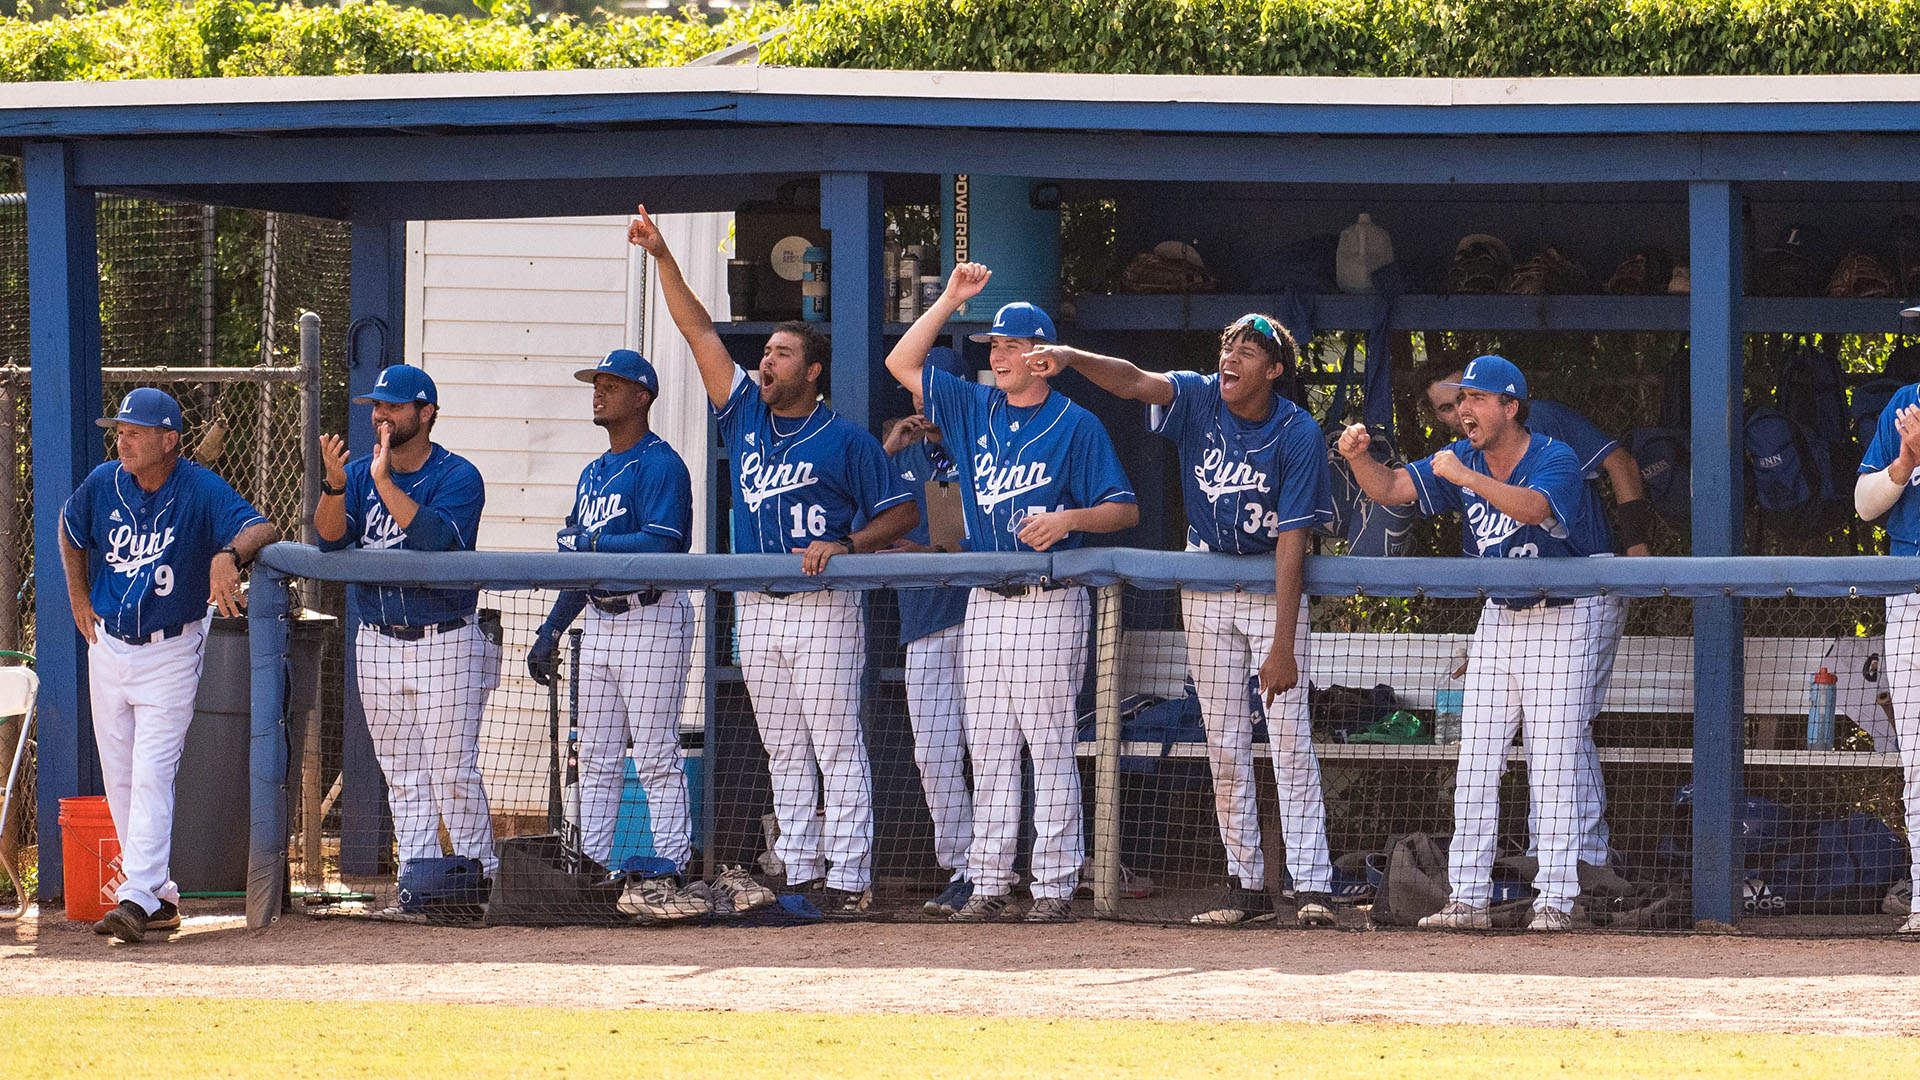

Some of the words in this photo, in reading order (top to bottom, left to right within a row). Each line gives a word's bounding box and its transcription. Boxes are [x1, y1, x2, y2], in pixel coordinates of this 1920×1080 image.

[955, 174, 968, 265] OWERAD
[992, 308, 1006, 327] L
[375, 370, 389, 387] L
[599, 352, 613, 367] L
[1463, 361, 1477, 380] L
[120, 396, 133, 413] L
[740, 452, 819, 514] Lynn
[974, 452, 1052, 515] Lynn
[1194, 448, 1271, 504] Lynn
[360, 501, 408, 549] Lyn
[577, 493, 628, 533] Lynn
[790, 502, 827, 538] 16
[1242, 502, 1279, 538] 34
[1467, 502, 1527, 557] Lyn
[105, 525, 175, 578] Lynn
[154, 564, 175, 597] 9
